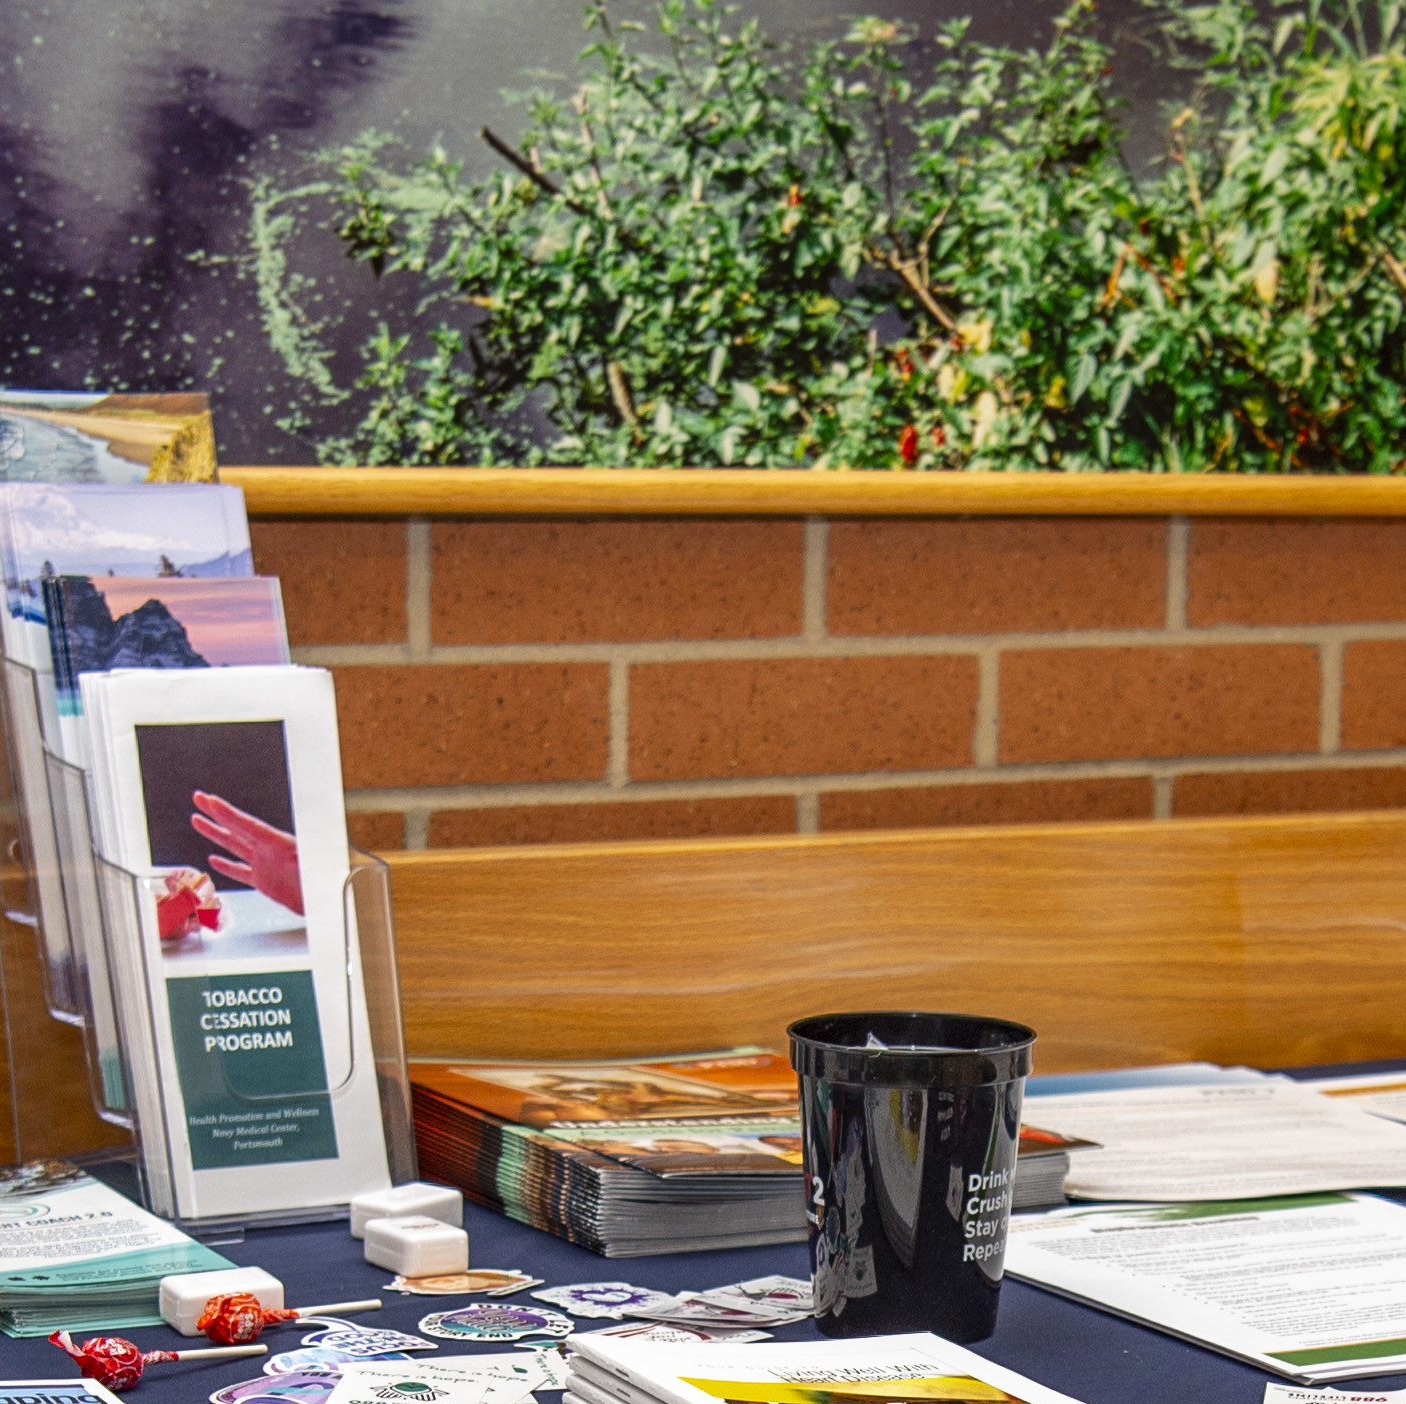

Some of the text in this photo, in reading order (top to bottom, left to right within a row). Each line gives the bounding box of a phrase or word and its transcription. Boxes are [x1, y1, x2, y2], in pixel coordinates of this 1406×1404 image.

[202, 986, 283, 1008] TOBACCO
[200, 1009, 292, 1031] CESSATION
[205, 1030, 294, 1053] PROGRAM
[190, 1106, 320, 1126] Health Promotion and Wellness
[237, 1124, 269, 1136] Medical
[270, 1122, 301, 1135] Center,
[233, 1137, 284, 1151] Portsmouth
[812, 1177, 826, 1205] 2
[967, 1168, 1009, 1192] Drink
[965, 1191, 1009, 1216] Crush
[964, 1218, 998, 1240] Stay
[962, 1239, 1006, 1263] Repea
[356, 1369, 409, 1380] There
[433, 1374, 479, 1385] hope.
[767, 1361, 939, 1380] Living Well With
[1350, 1394, 1388, 1403] 988
